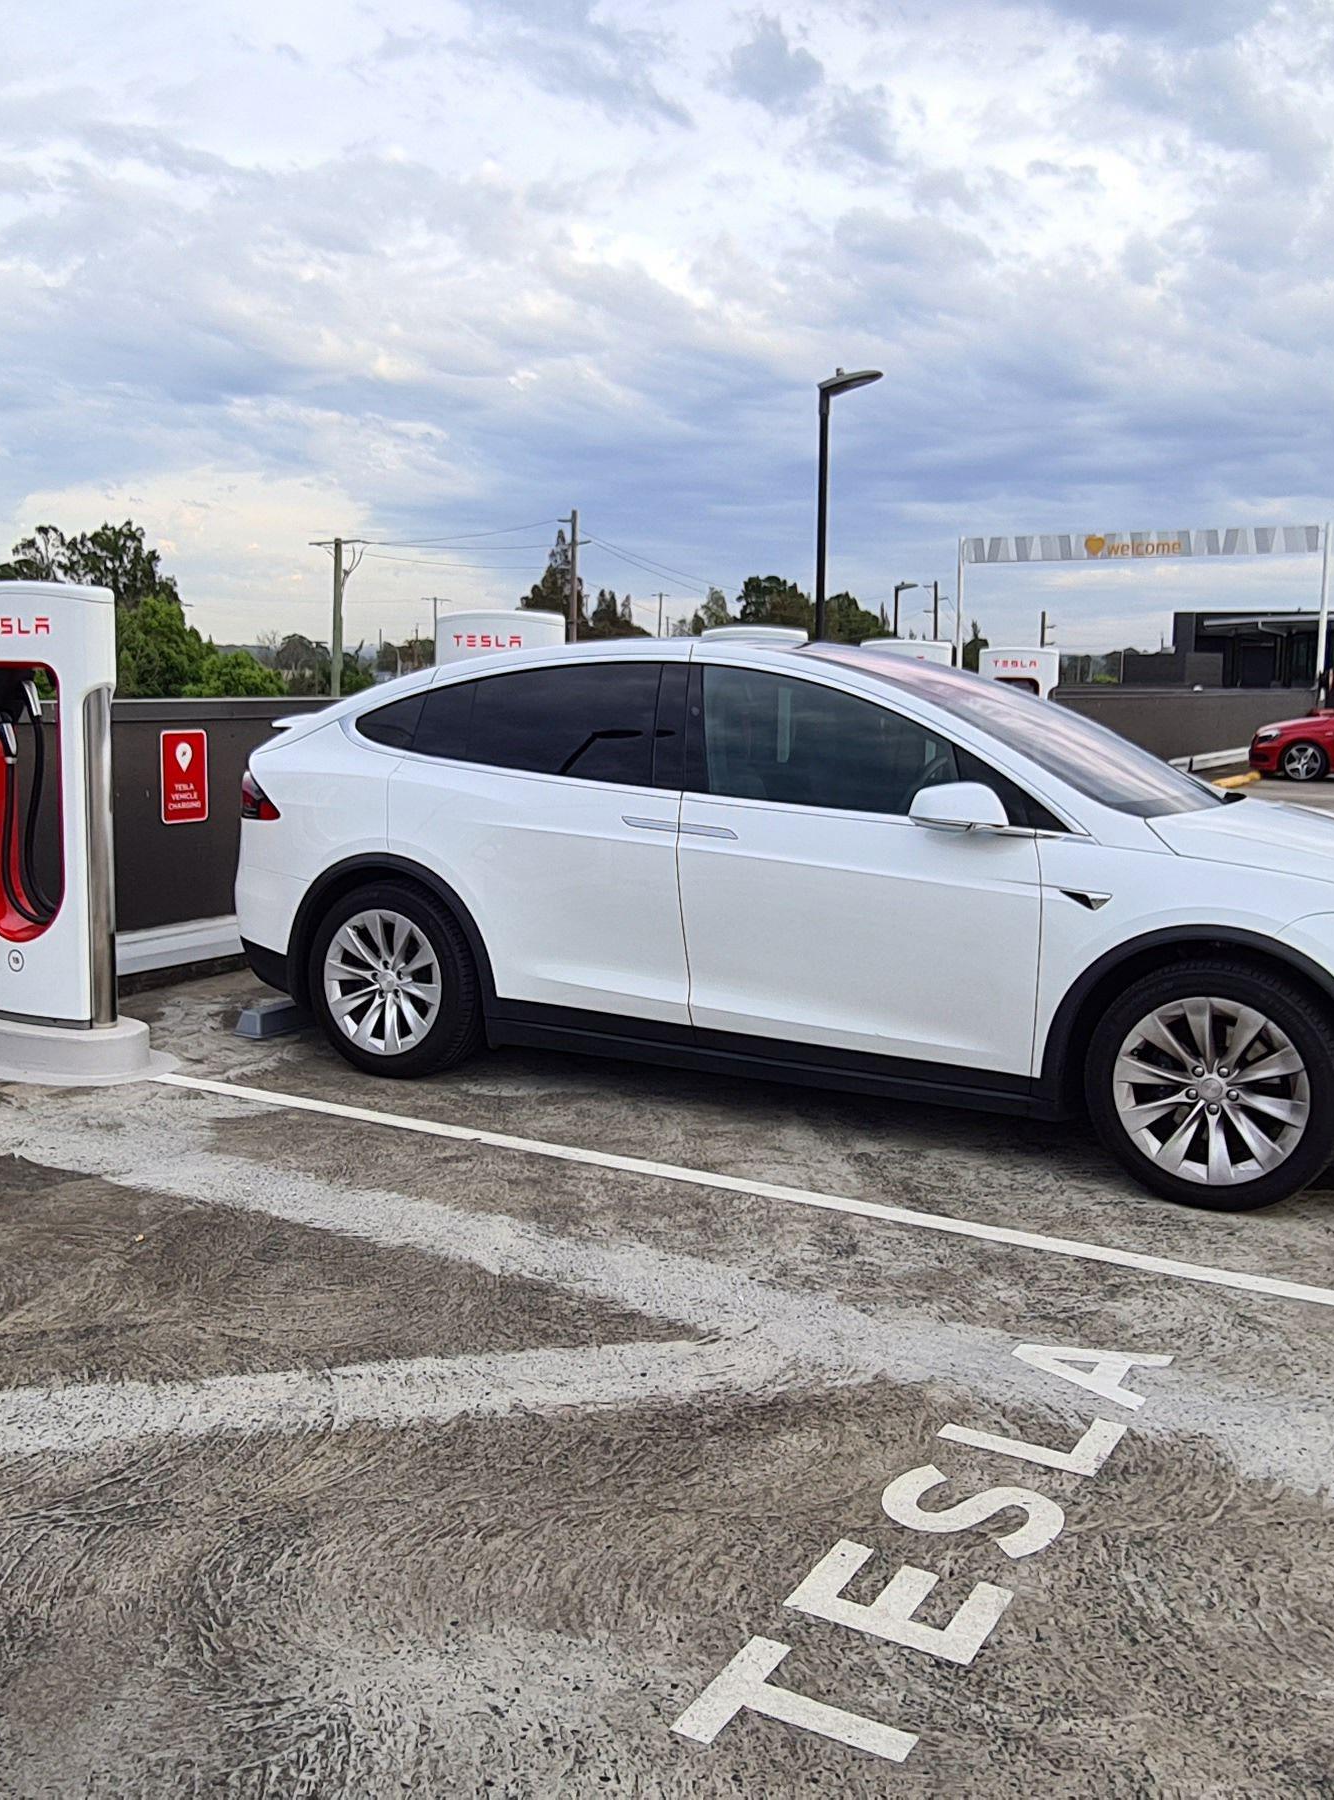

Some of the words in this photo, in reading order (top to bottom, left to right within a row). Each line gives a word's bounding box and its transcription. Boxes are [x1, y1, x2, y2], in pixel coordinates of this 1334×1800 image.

[1108, 541, 1182, 556] welcome
[453, 634, 522, 648] TESLA
[992, 659, 1038, 668] TESLA
[174, 783, 195, 791] TESLA
[670, 1344, 1174, 1763] TESLA
